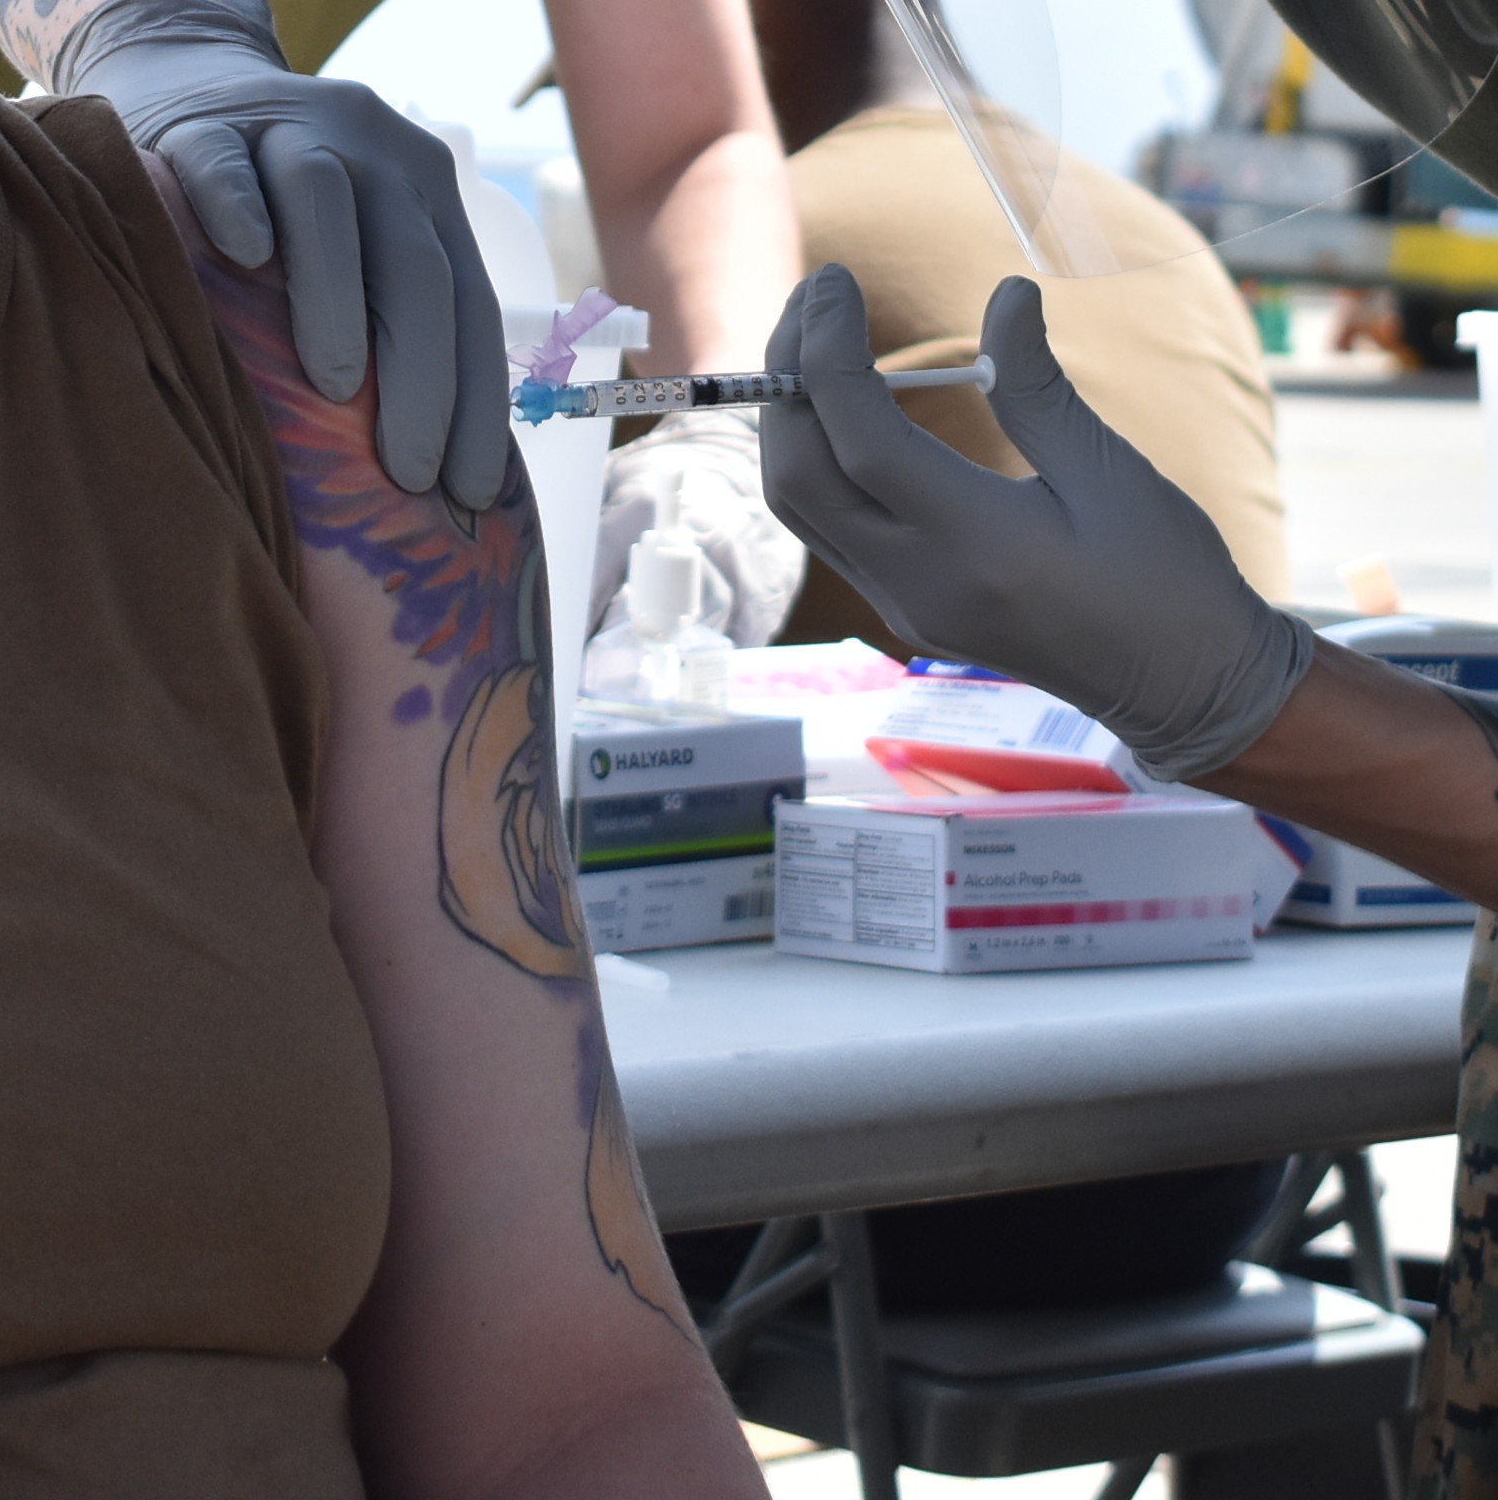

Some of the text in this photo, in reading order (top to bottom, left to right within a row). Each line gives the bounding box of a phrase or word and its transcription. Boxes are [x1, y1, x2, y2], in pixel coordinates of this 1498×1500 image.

[614, 385, 627, 405] 0.1
[633, 382, 646, 404] 0.2
[653, 382, 666, 402] 0.3
[672, 381, 686, 401] 0.4
[731, 377, 744, 398] 0.7
[751, 376, 764, 397] 0.8
[772, 375, 783, 397] 0.9
[615, 747, 694, 770] HALYARD
[663, 792, 682, 812] SG
[964, 870, 1083, 888] Alcohol Prep Pads
